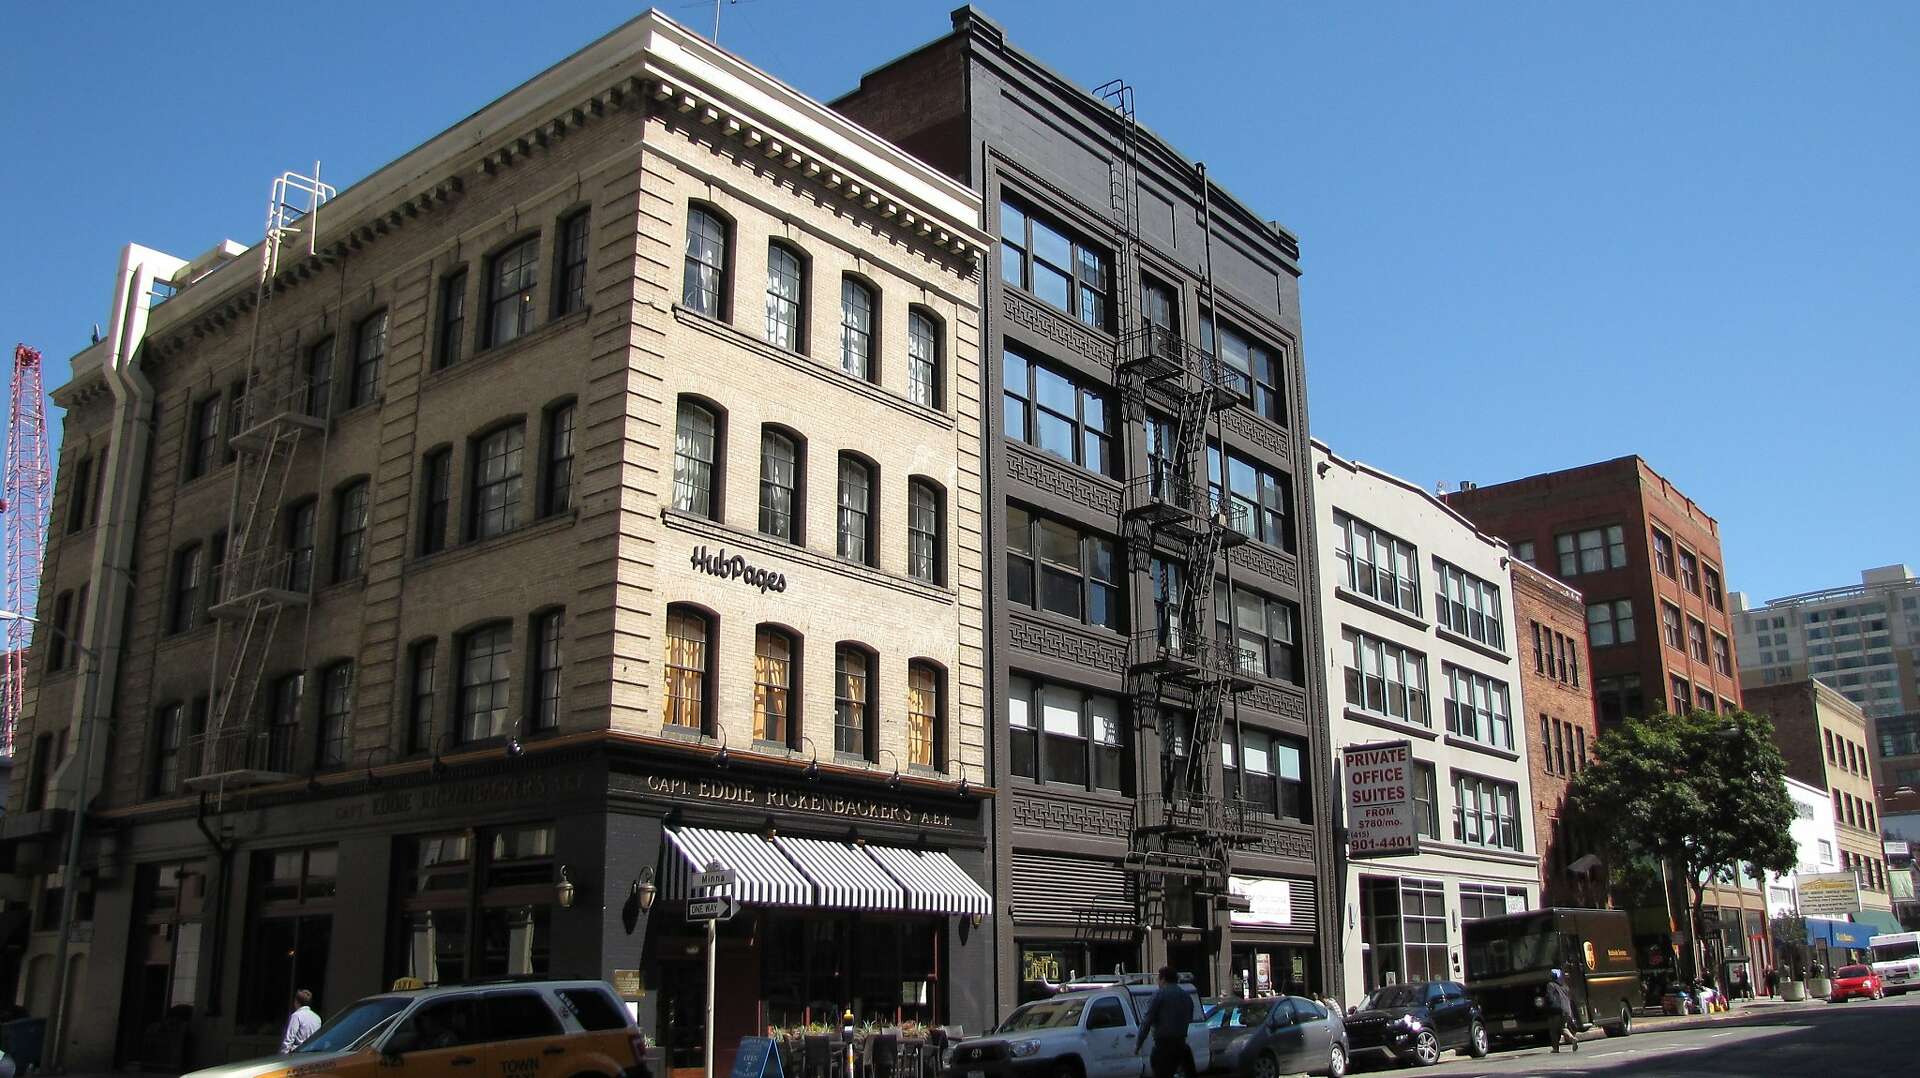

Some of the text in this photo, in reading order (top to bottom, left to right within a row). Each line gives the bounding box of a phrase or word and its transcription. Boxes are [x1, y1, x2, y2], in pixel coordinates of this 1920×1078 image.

[691, 546, 787, 594] HubPages
[1345, 749, 1406, 767] PRIVATE
[1352, 767, 1403, 785] OFFICE
[698, 780, 755, 803] EDDIE
[765, 789, 912, 822] RICKENBACKERS
[1352, 786, 1405, 804] SUITES
[1366, 808, 1394, 818] FROM
[1359, 819, 1403, 829] $780/mo.
[1350, 831, 1370, 839] (415)
[1351, 836, 1412, 851] 901-4401
[701, 874, 725, 885] Minna
[691, 903, 718, 914] ONE WAY
[500, 1057, 539, 1073] TOWN
